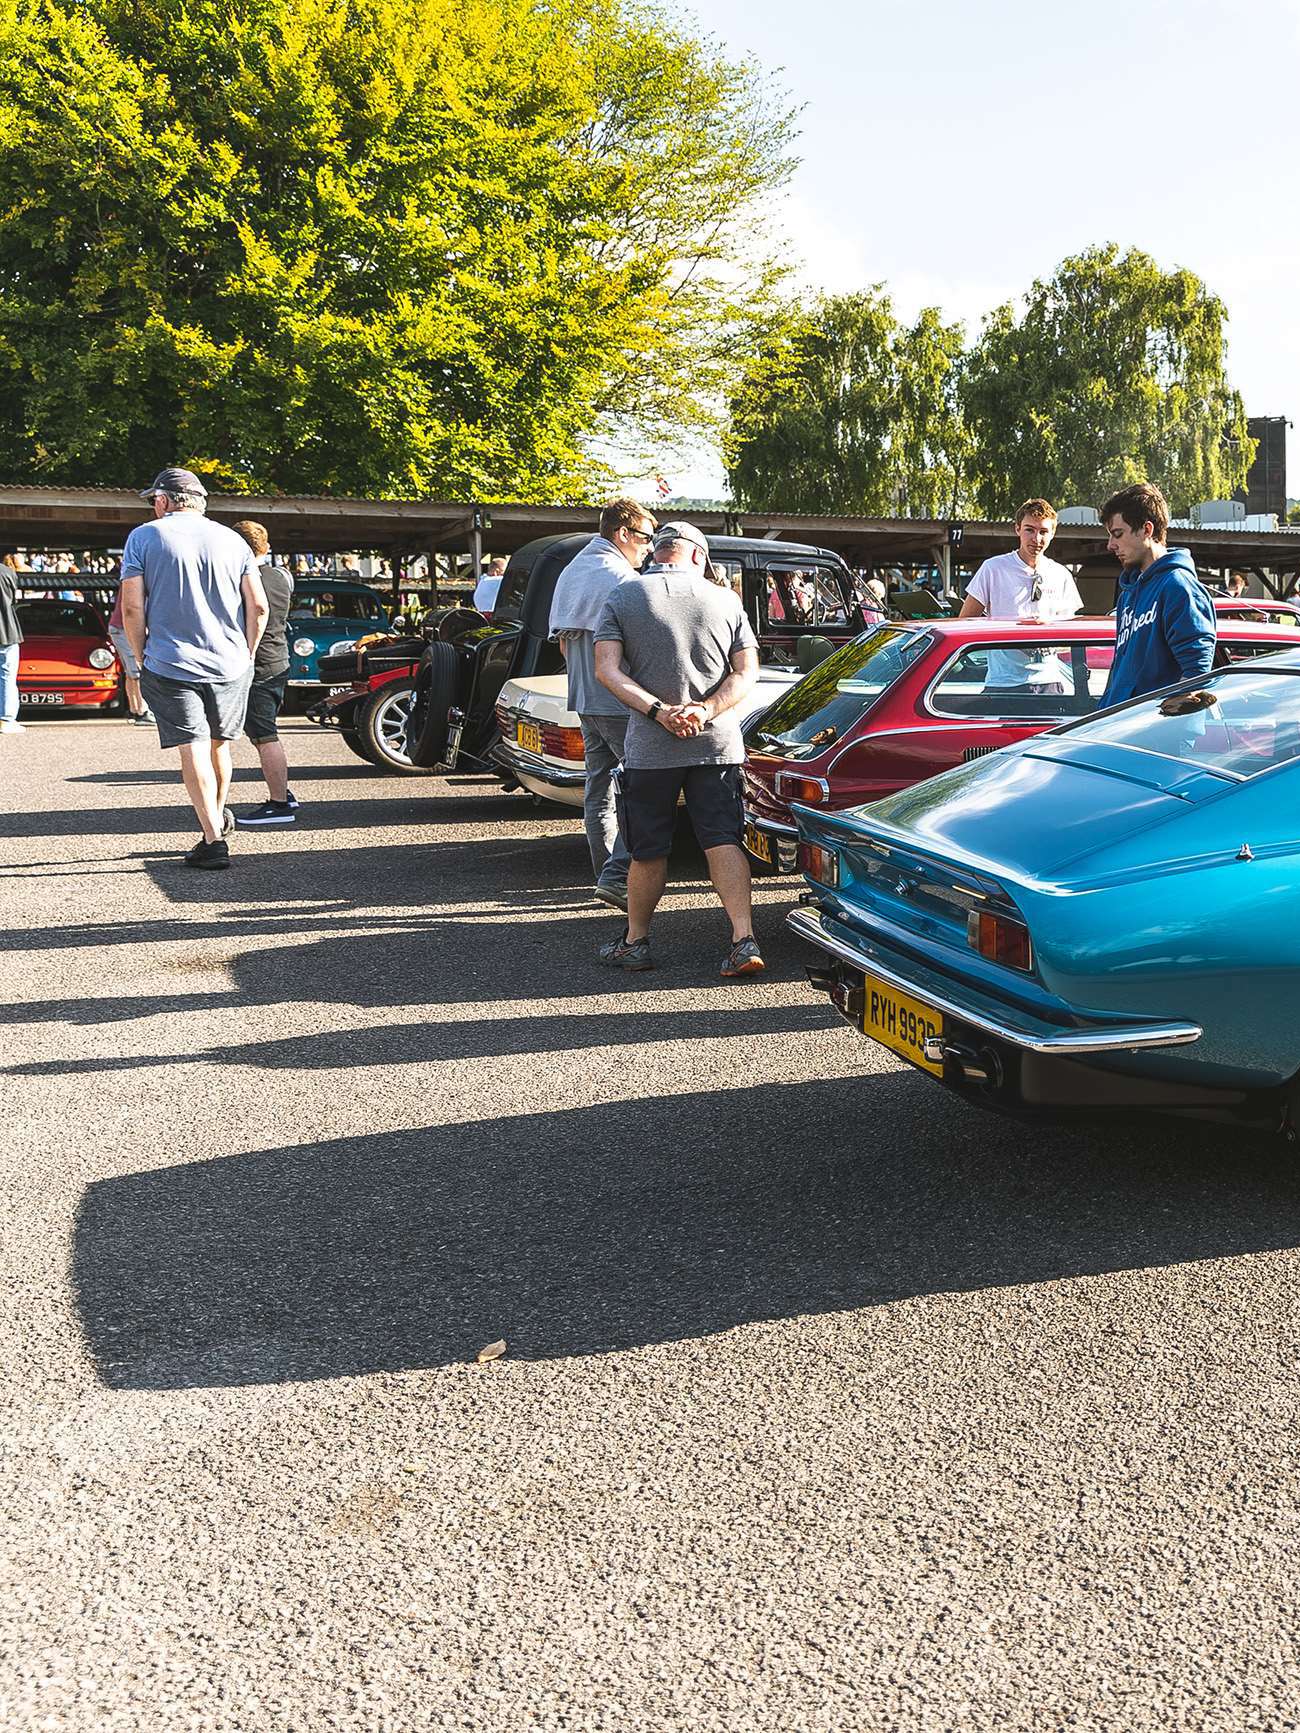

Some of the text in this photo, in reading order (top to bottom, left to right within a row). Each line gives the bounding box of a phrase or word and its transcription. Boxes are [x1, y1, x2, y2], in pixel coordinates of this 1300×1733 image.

[952, 529, 962, 540] 77
[31, 693, 63, 704] 879S
[871, 991, 896, 1035] RYH
